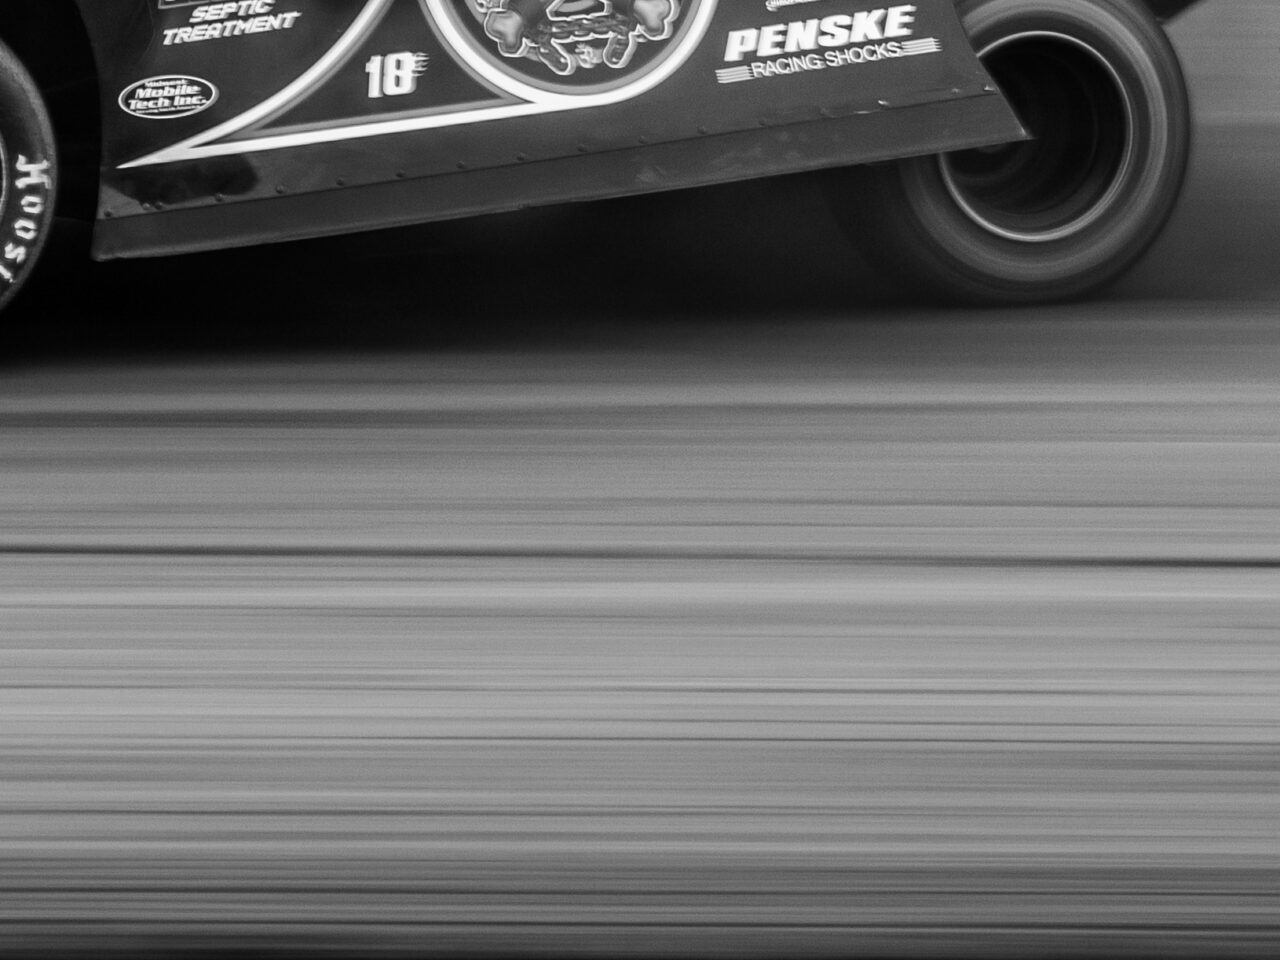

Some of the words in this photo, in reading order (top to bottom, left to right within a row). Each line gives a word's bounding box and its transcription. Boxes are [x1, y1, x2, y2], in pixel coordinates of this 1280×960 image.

[163, 11, 303, 45] TREATMENT
[724, 4, 917, 62] PENSKE
[365, 52, 418, 98] 18
[750, 53, 824, 77] RACING
[824, 41, 903, 67] SHOCKS
[128, 98, 171, 110] Tech
[135, 85, 201, 99] Mobile
